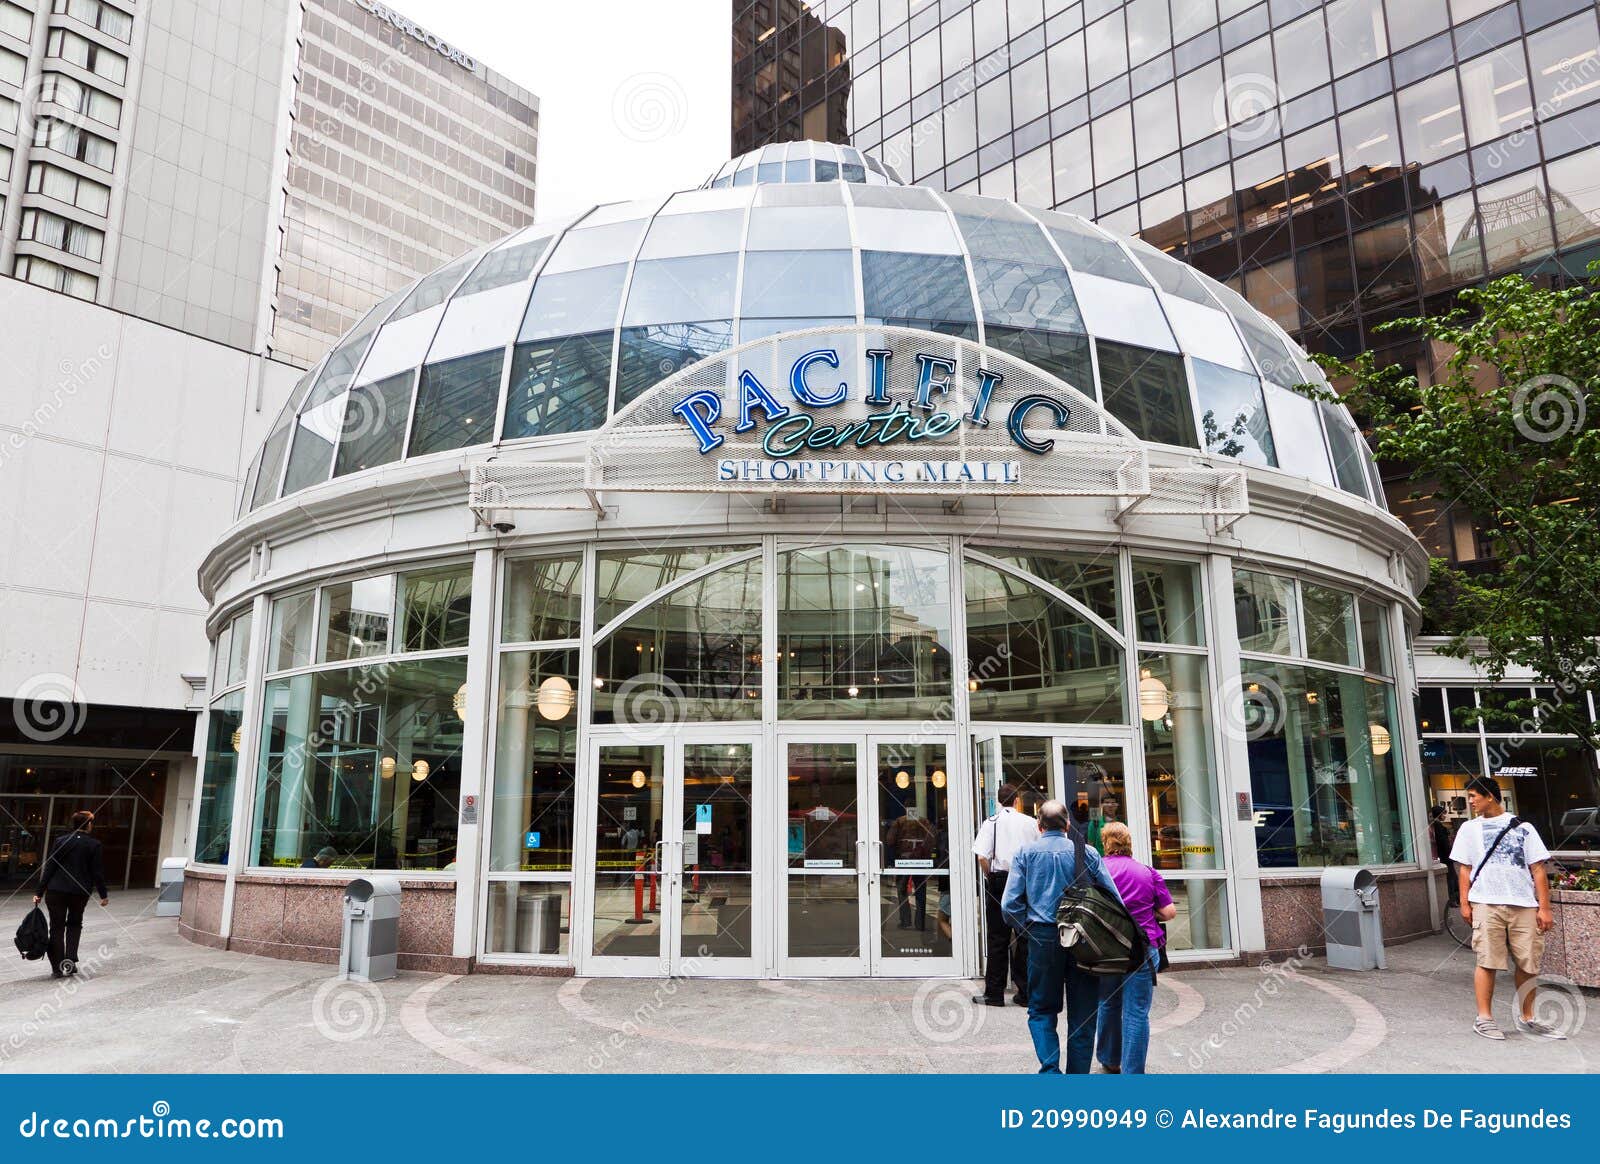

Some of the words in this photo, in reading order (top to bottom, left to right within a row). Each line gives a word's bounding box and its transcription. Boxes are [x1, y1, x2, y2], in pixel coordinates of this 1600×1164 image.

[672, 348, 1071, 456] PACIFIC
[762, 402, 964, 458] Centre
[719, 460, 905, 483] SHOPPING
[920, 461, 1020, 483] MALL
[1496, 766, 1538, 775] BOSE
